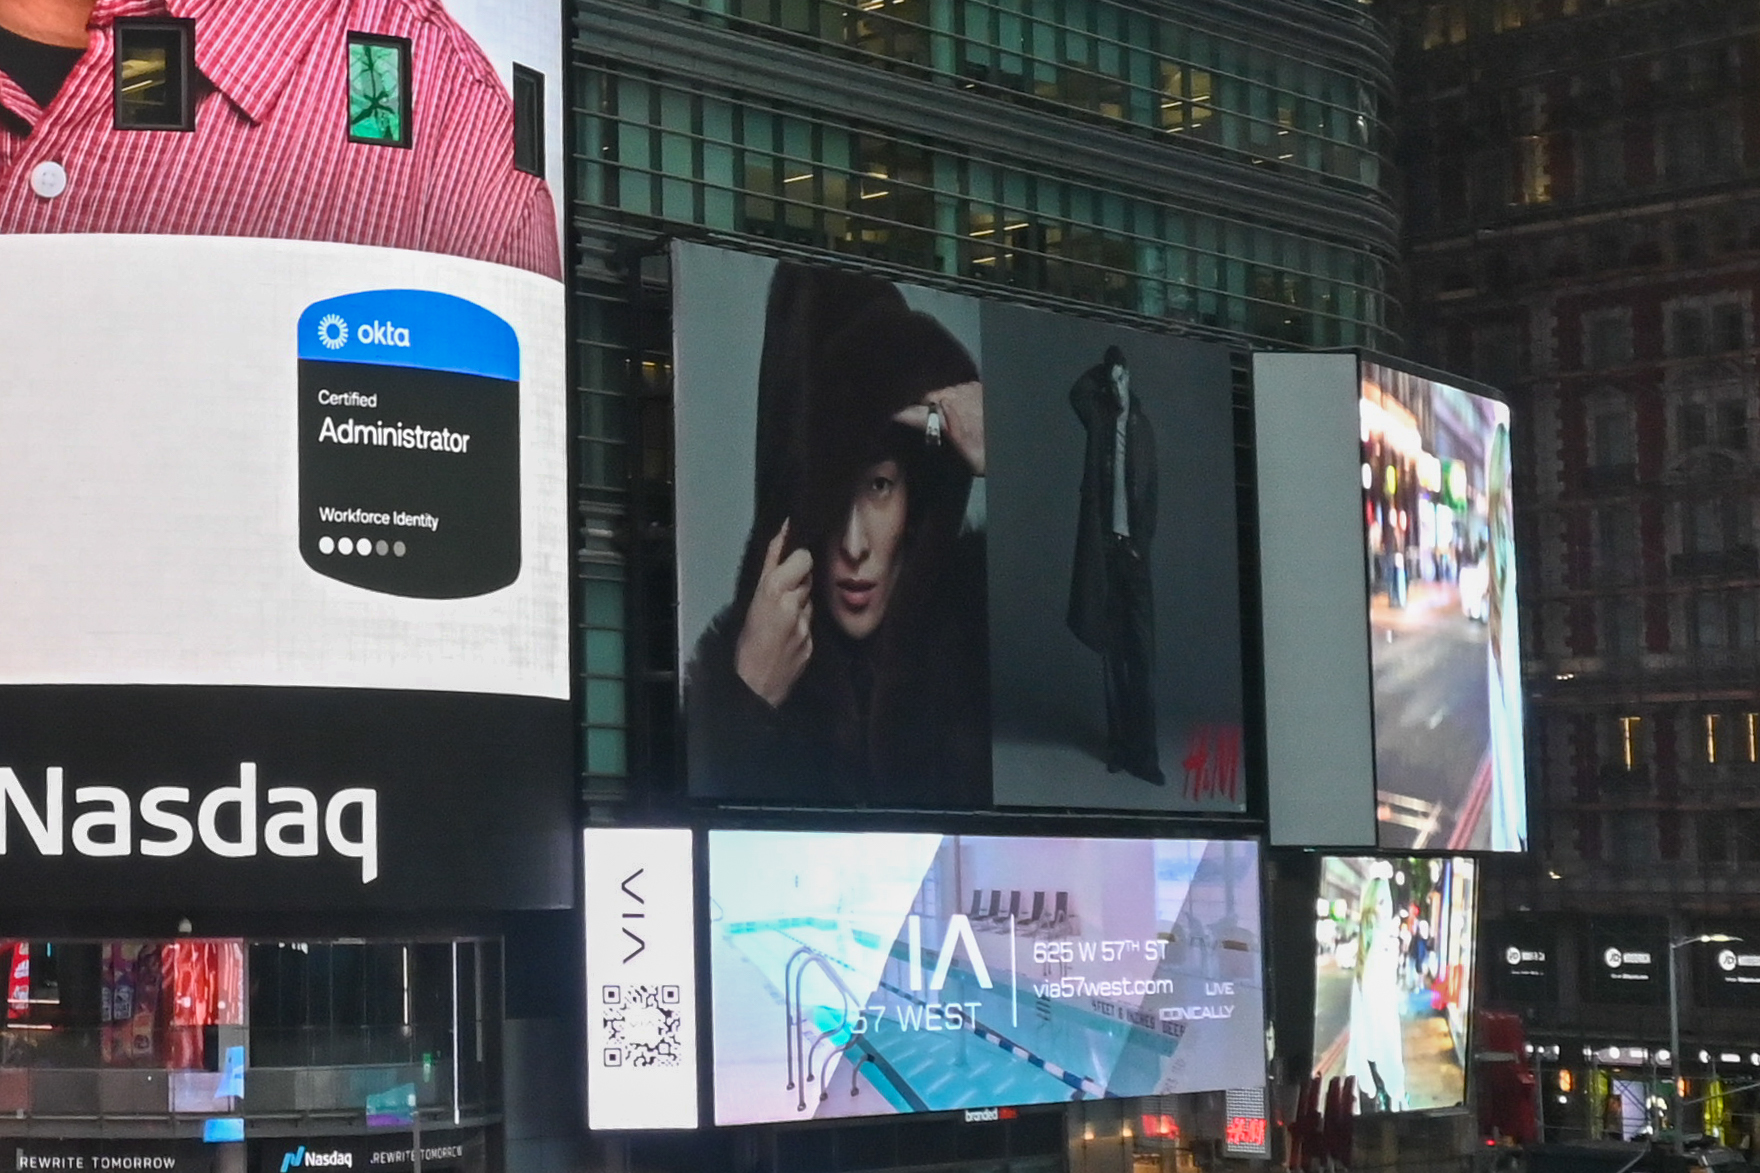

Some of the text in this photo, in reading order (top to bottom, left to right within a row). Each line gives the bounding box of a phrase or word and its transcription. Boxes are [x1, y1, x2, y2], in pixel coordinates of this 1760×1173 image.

[357, 320, 411, 348] okta
[318, 389, 378, 408] Certified
[318, 416, 470, 453] Administrator
[319, 507, 439, 532] Workforce Identity
[1033, 941, 1073, 964] 625
[1079, 941, 1097, 962] W
[1145, 939, 1169, 961] ST
[1033, 976, 1173, 998] via57west.com
[1206, 982, 1235, 996] LIVE
[850, 1002, 982, 1035] 57 WEST
[20, 1156, 175, 1169] REWRITE TOMORROW
[304, 1150, 353, 1168] Nasdaq
